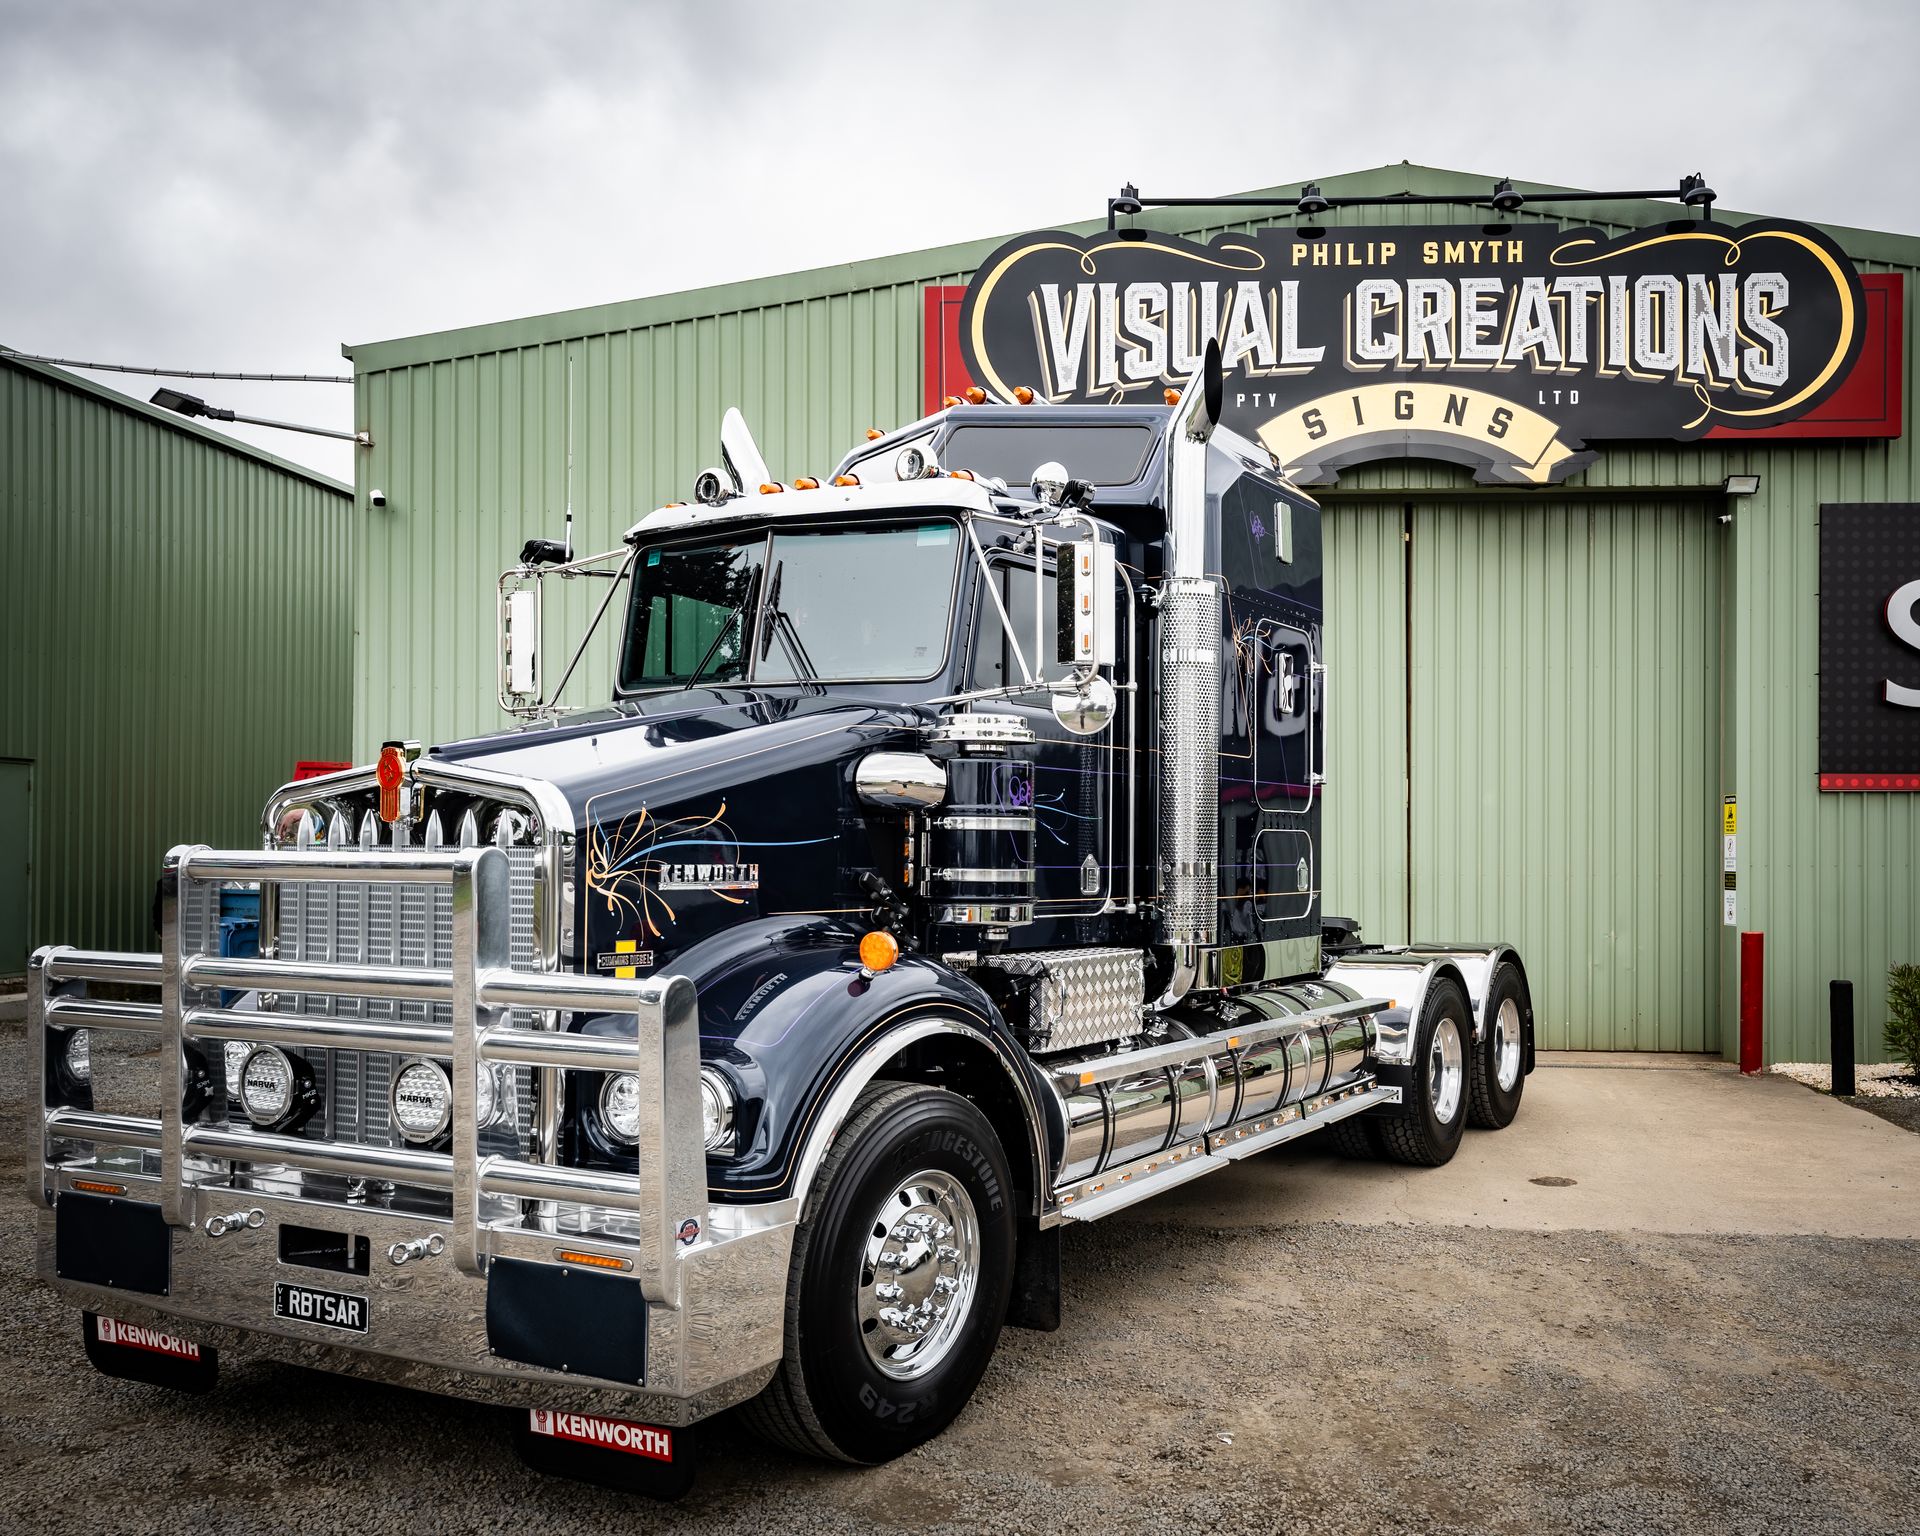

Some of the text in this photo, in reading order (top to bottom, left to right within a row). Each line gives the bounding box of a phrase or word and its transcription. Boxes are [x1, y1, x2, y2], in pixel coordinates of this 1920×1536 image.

[1291, 240, 1523, 266] PHILIP SMYTH
[1038, 272, 1790, 394] VISUAL CREATIONS
[1236, 393, 1277, 408] PTY
[1538, 390, 1579, 405] LTD
[1301, 390, 1514, 440] SIGNS
[660, 863, 759, 883] KENWORTH
[601, 953, 651, 966] CUMMINS DIESEL
[247, 1079, 276, 1089] NARVA
[400, 1094, 432, 1104] NARVA
[289, 1289, 360, 1327] RBTSAR
[117, 1322, 199, 1357] KENWORTH
[556, 1412, 669, 1456] KENWORTH
